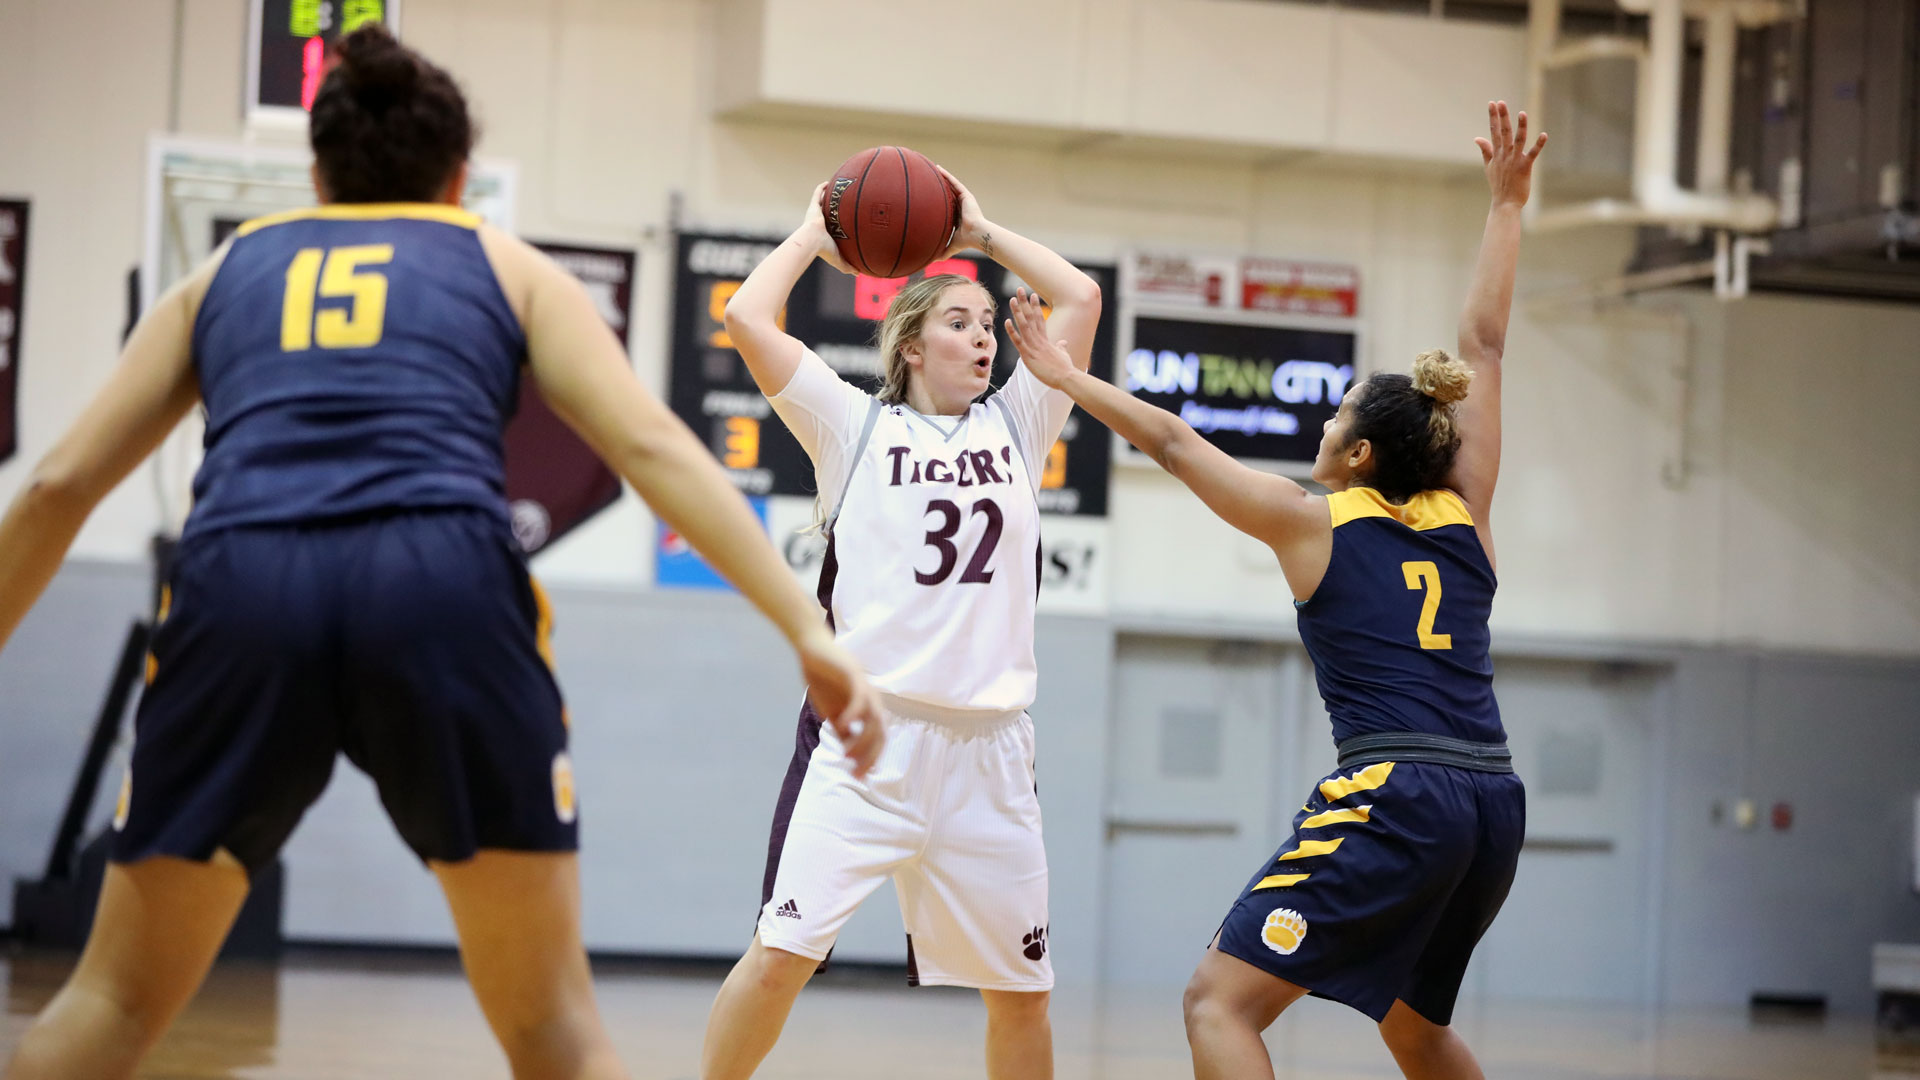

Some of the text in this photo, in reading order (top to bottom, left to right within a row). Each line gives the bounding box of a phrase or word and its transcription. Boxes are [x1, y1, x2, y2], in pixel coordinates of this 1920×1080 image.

[280, 243, 394, 352] 15
[1126, 349, 1354, 406] SUN TAN CITY
[725, 416, 760, 469] 3
[913, 498, 1004, 585] 32
[1401, 561, 1452, 650] 2
[776, 909, 801, 920] adidas
